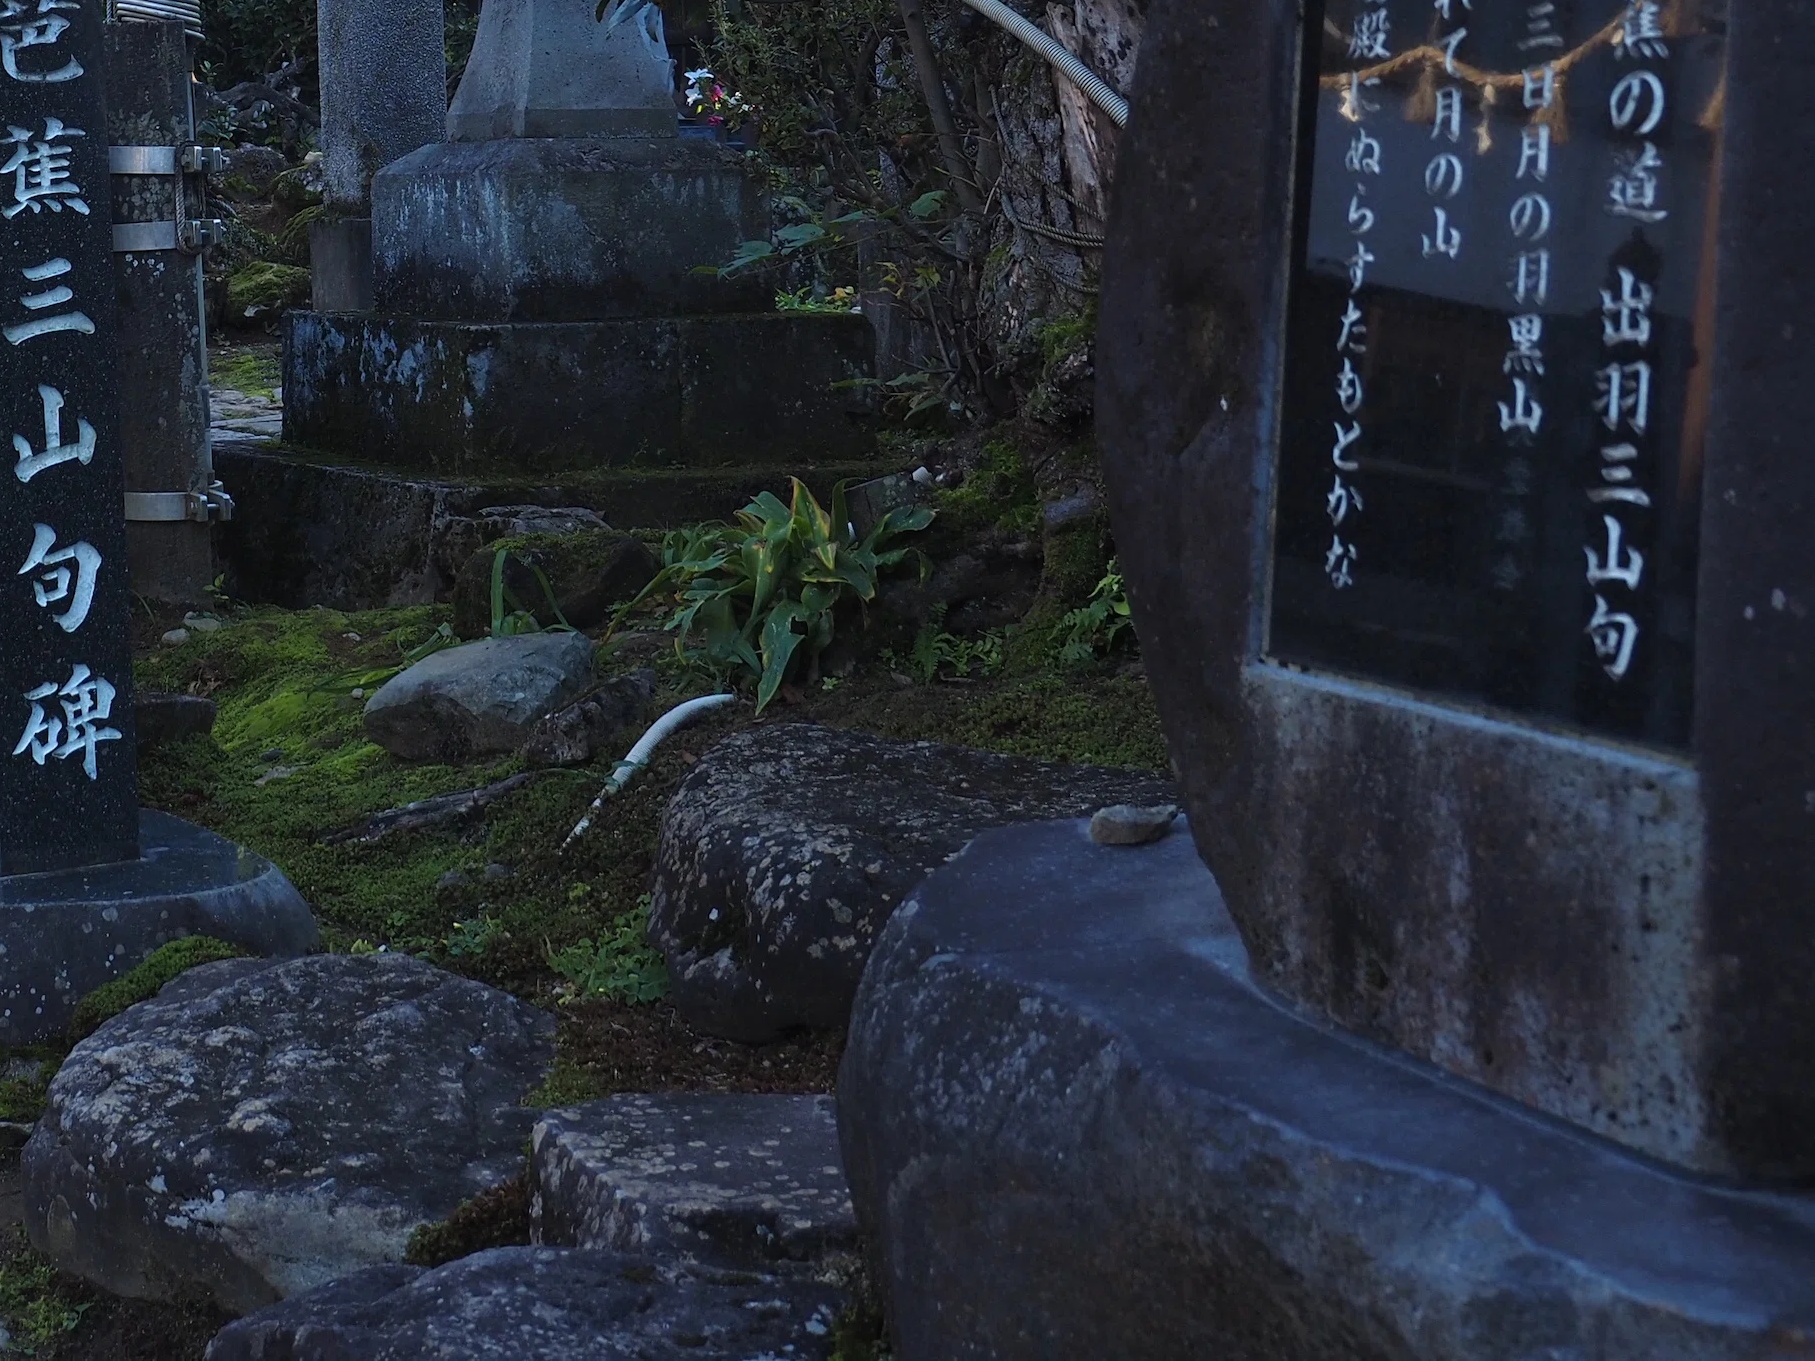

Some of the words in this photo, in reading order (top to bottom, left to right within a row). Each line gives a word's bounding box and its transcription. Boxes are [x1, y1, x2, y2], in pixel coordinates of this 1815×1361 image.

[1583, 267, 1654, 682] 出羽三山句
